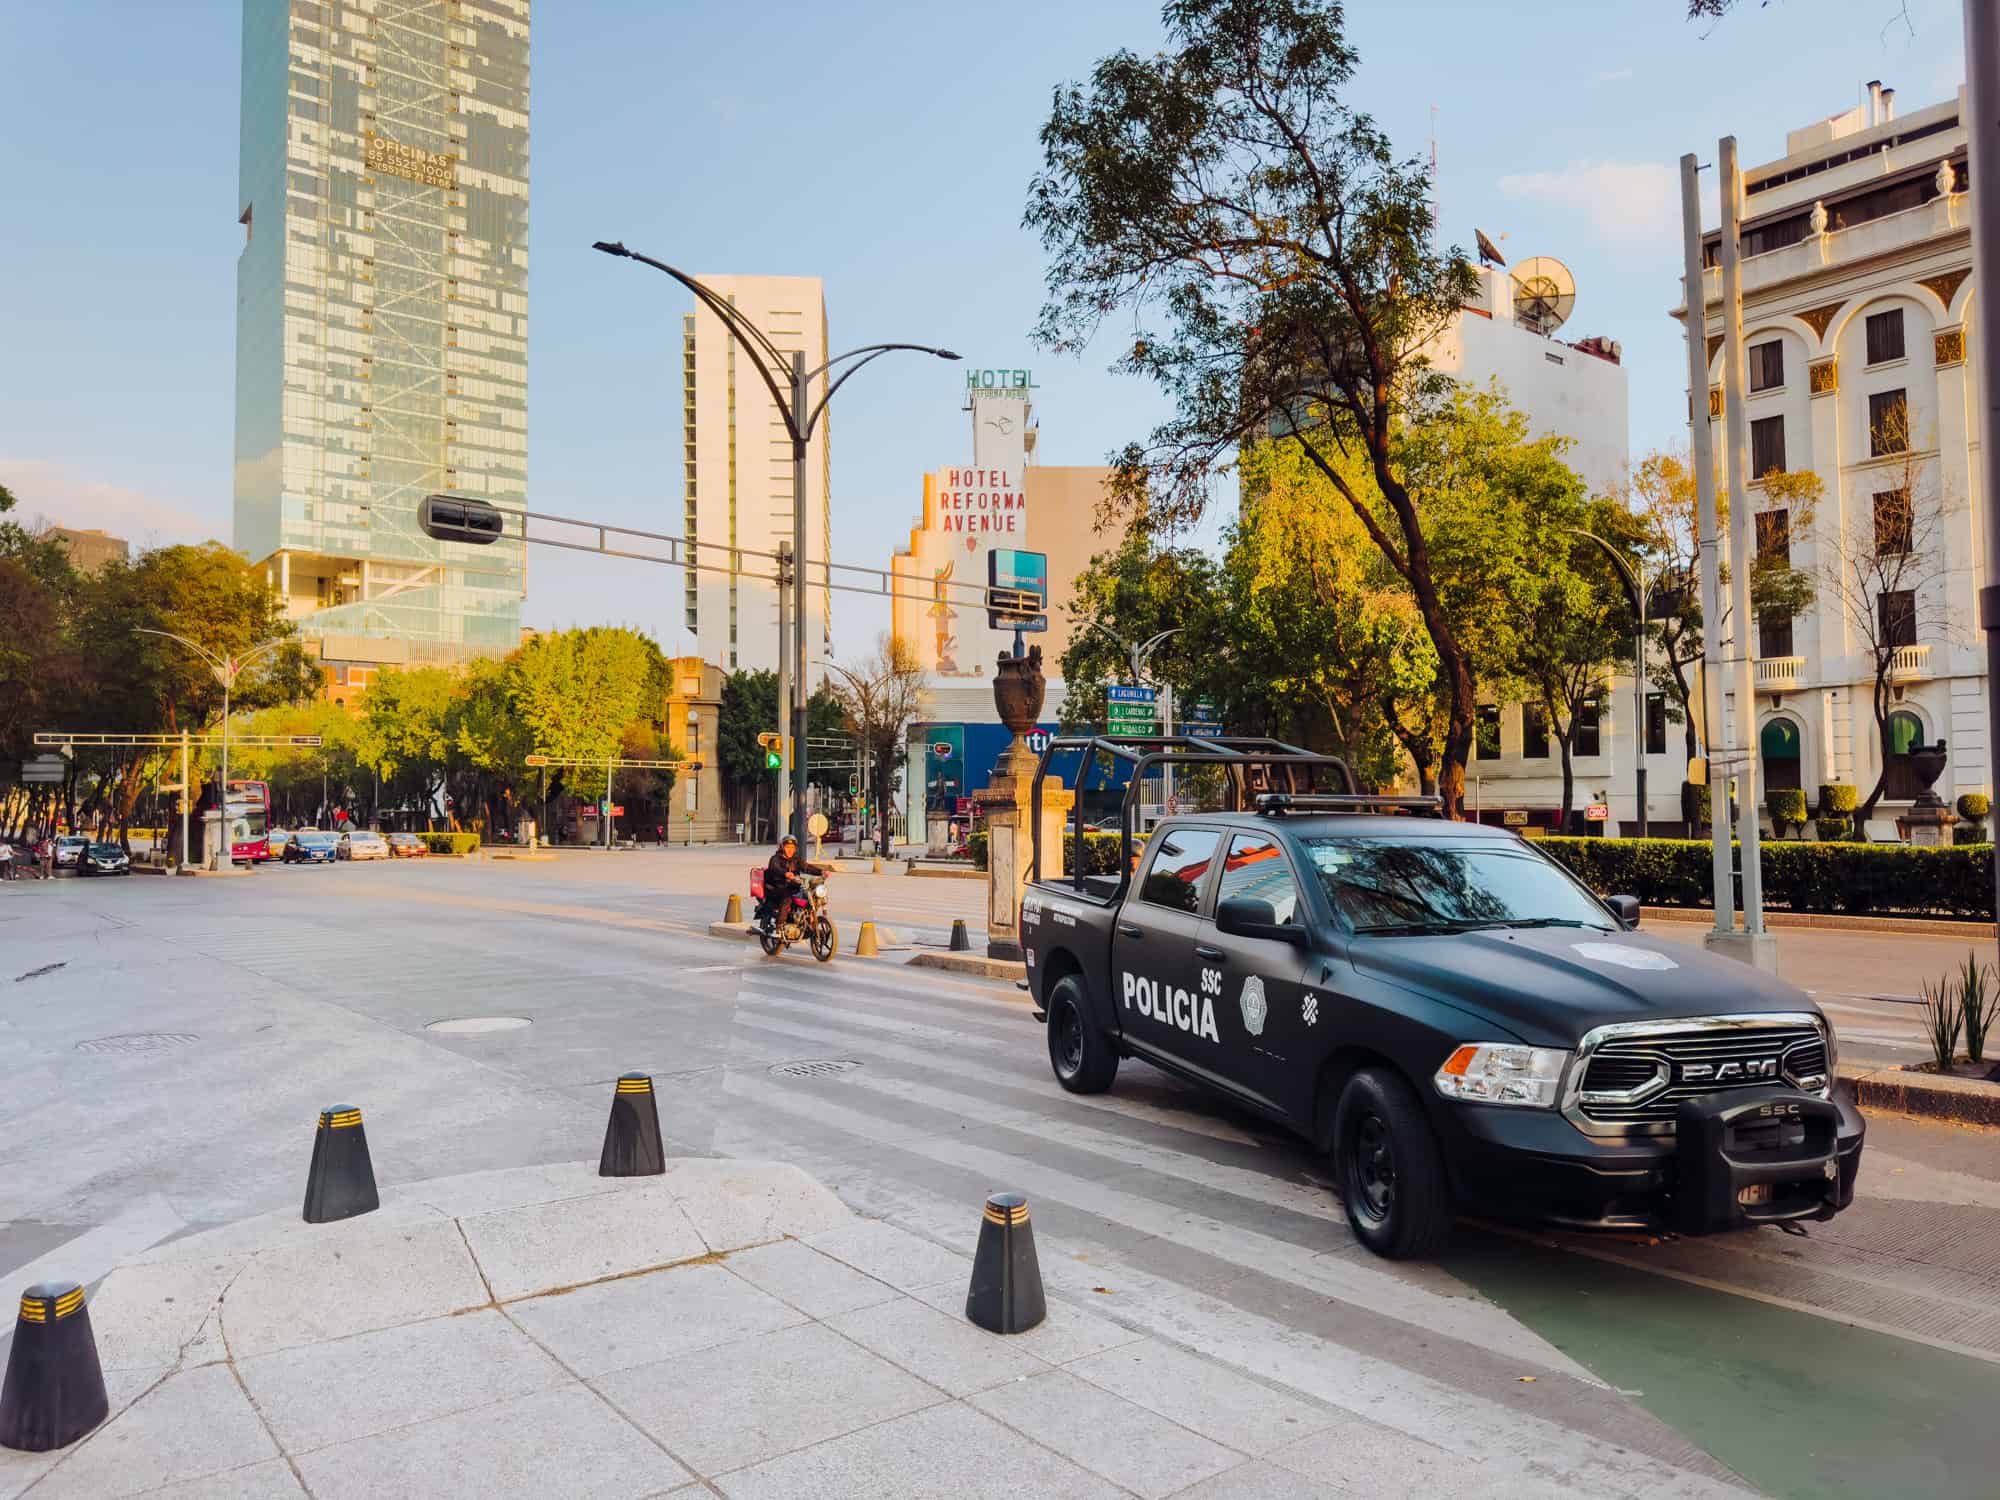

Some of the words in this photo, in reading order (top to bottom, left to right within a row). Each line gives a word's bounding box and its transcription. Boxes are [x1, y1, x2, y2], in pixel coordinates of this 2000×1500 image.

[373, 138, 448, 168] OFICINAS
[367, 150, 384, 162] 55
[387, 156, 419, 172] 5525
[422, 164, 453, 180] 1000
[966, 368, 1041, 389] HOTEL
[949, 470, 1011, 488] HOTEL
[940, 492, 1025, 511] REFORMA
[943, 515, 1016, 533] AVENUE
[1200, 967, 1223, 997] SSC
[1121, 971, 1221, 1045] POLICIA
[1680, 1058, 1778, 1082] RAM
[1758, 1104, 1801, 1118] SSC
